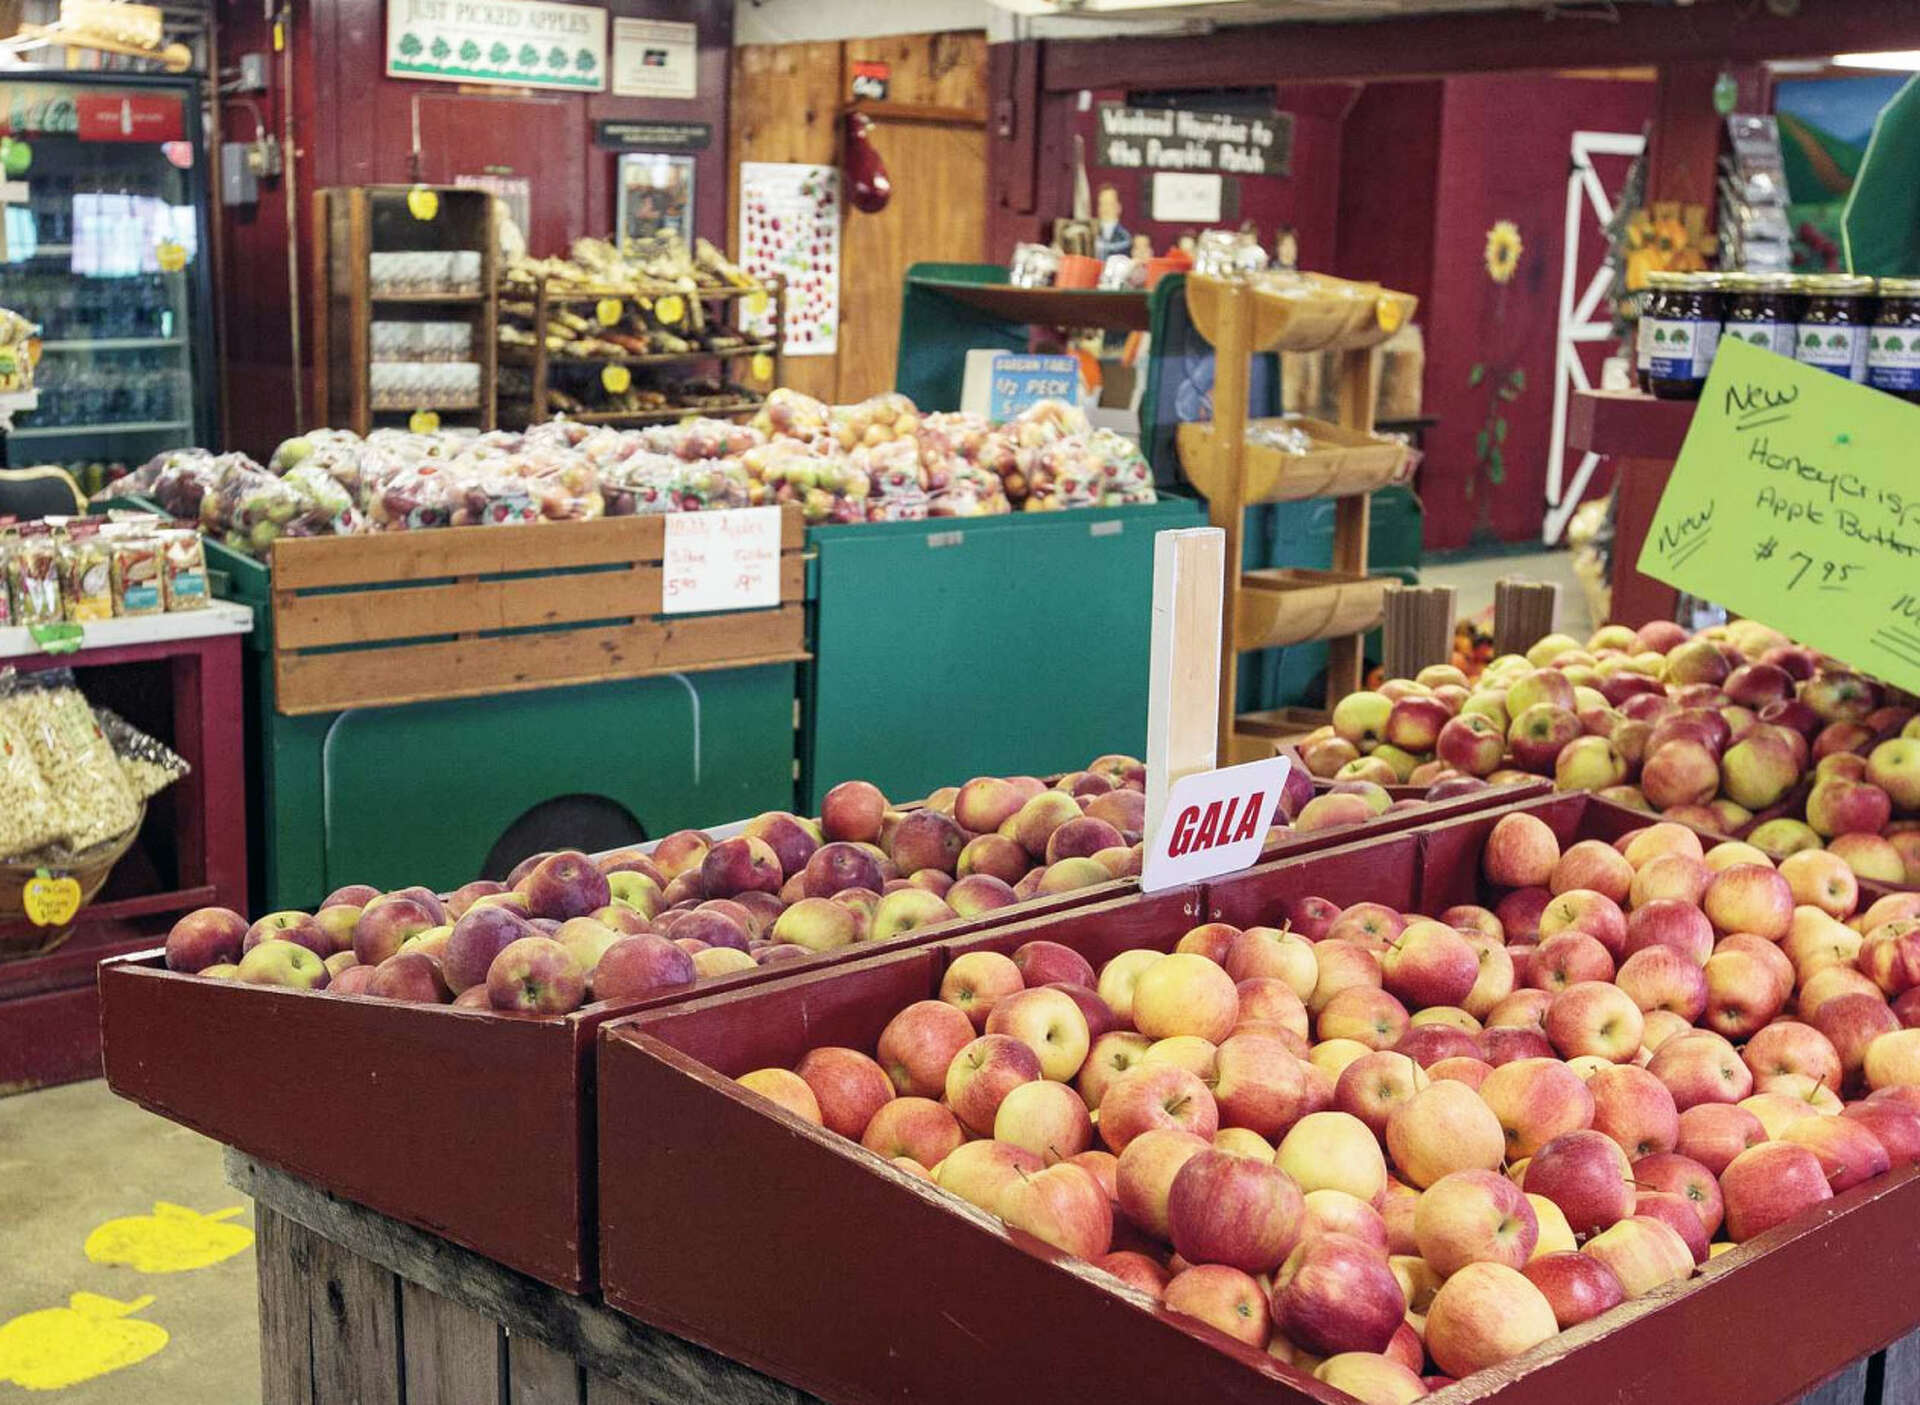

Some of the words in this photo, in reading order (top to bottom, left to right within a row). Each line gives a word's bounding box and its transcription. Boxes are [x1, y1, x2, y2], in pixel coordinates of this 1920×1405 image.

[406, 0, 449, 23] JUST
[456, 3, 520, 26] PICKED
[530, 9, 592, 34] APPLES
[1725, 383, 1799, 416] New
[1168, 791, 1265, 858] GALA
